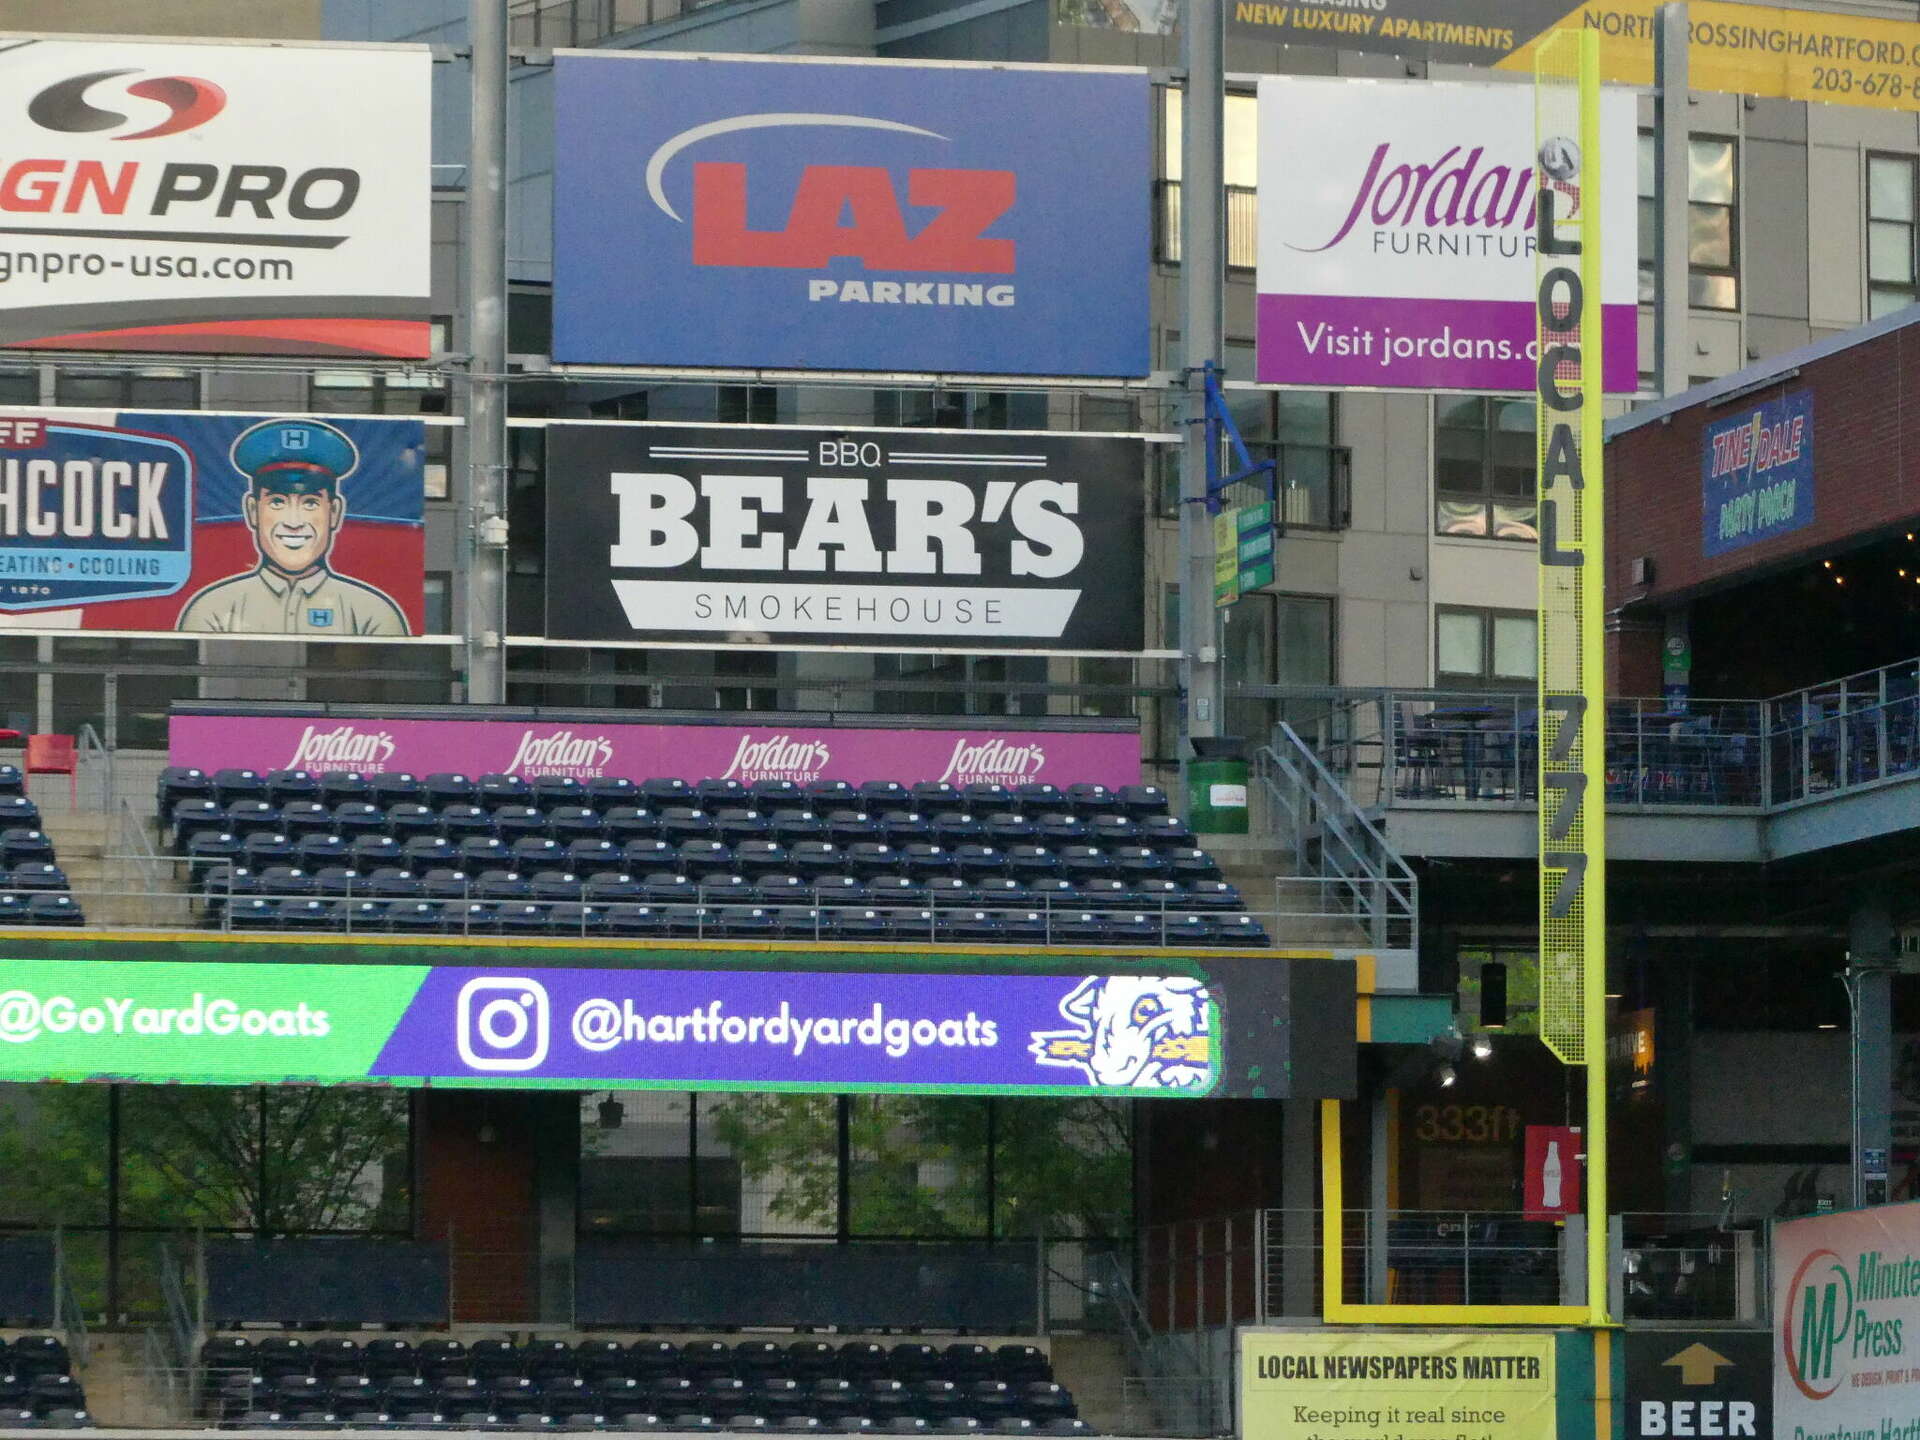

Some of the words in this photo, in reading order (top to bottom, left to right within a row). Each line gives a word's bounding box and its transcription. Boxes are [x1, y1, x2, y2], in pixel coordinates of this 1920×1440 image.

[1235, 2, 1289, 26] NEW
[1292, 8, 1376, 34] LUXURY
[1379, 16, 1515, 49] APARTMENTS
[0, 158, 140, 215] GN
[149, 162, 361, 221] PRO
[692, 161, 1017, 274] LAZ
[1373, 231, 1540, 259] FURNITUR
[0, 251, 294, 283] gnpro-usa.com
[808, 279, 1016, 307] PARKING
[1297, 321, 1374, 355] Visit
[1538, 189, 1586, 567] LOCAL
[818, 441, 882, 468] BBQ
[610, 472, 1085, 578] BEAR'S
[694, 593, 1003, 624] SMOKEHOUSE
[284, 725, 396, 772] Jordan's
[305, 762, 385, 774] FURNITURE
[503, 730, 613, 776] Jordan's
[722, 734, 831, 780] Jordan's
[938, 738, 1046, 784] Jordan's
[524, 766, 603, 778] FURNITURE
[742, 770, 820, 782] FURNITURE
[0, 990, 330, 1042] @GoYardGoats
[571, 998, 999, 1057] @hartfordyardgoats
[1853, 1309, 1903, 1359] Press
[1258, 1356, 1319, 1379] LOCAL
[1323, 1356, 1457, 1379] NEWSPAPERS
[1463, 1356, 1540, 1379] MATTER
[1294, 1405, 1381, 1428] Keeping
[1387, 1405, 1400, 1423] it
[1406, 1406, 1445, 1423] real
[1451, 1406, 1506, 1423] since
[1640, 1400, 1756, 1437] BEER
